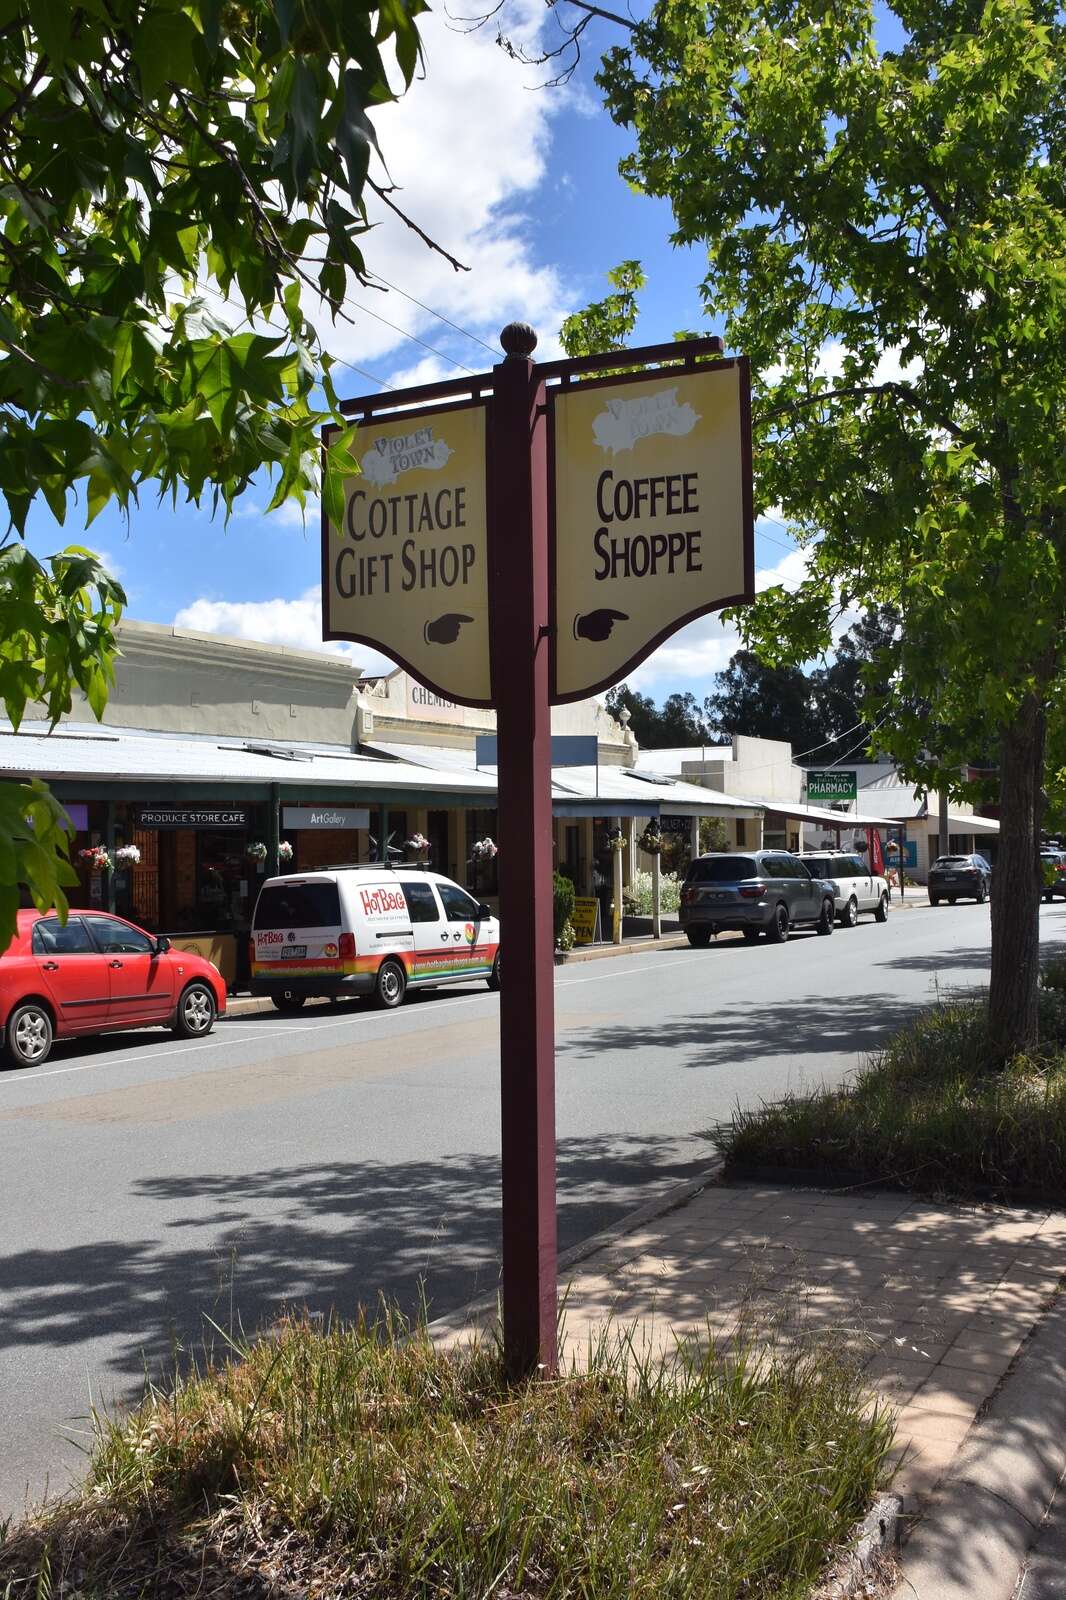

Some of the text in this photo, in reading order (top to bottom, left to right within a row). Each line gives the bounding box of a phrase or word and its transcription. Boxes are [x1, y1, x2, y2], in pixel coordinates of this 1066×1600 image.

[391, 446, 435, 473] TOWN
[348, 487, 466, 541] COTTAGE
[597, 470, 699, 523] COFFEE
[335, 539, 475, 599] GIFT SHOP
[594, 527, 702, 581] SHOPPE
[412, 686, 457, 708] CHEM
[809, 782, 853, 793] PHARMACY
[141, 813, 246, 823] PRODUCE STORE CAFE
